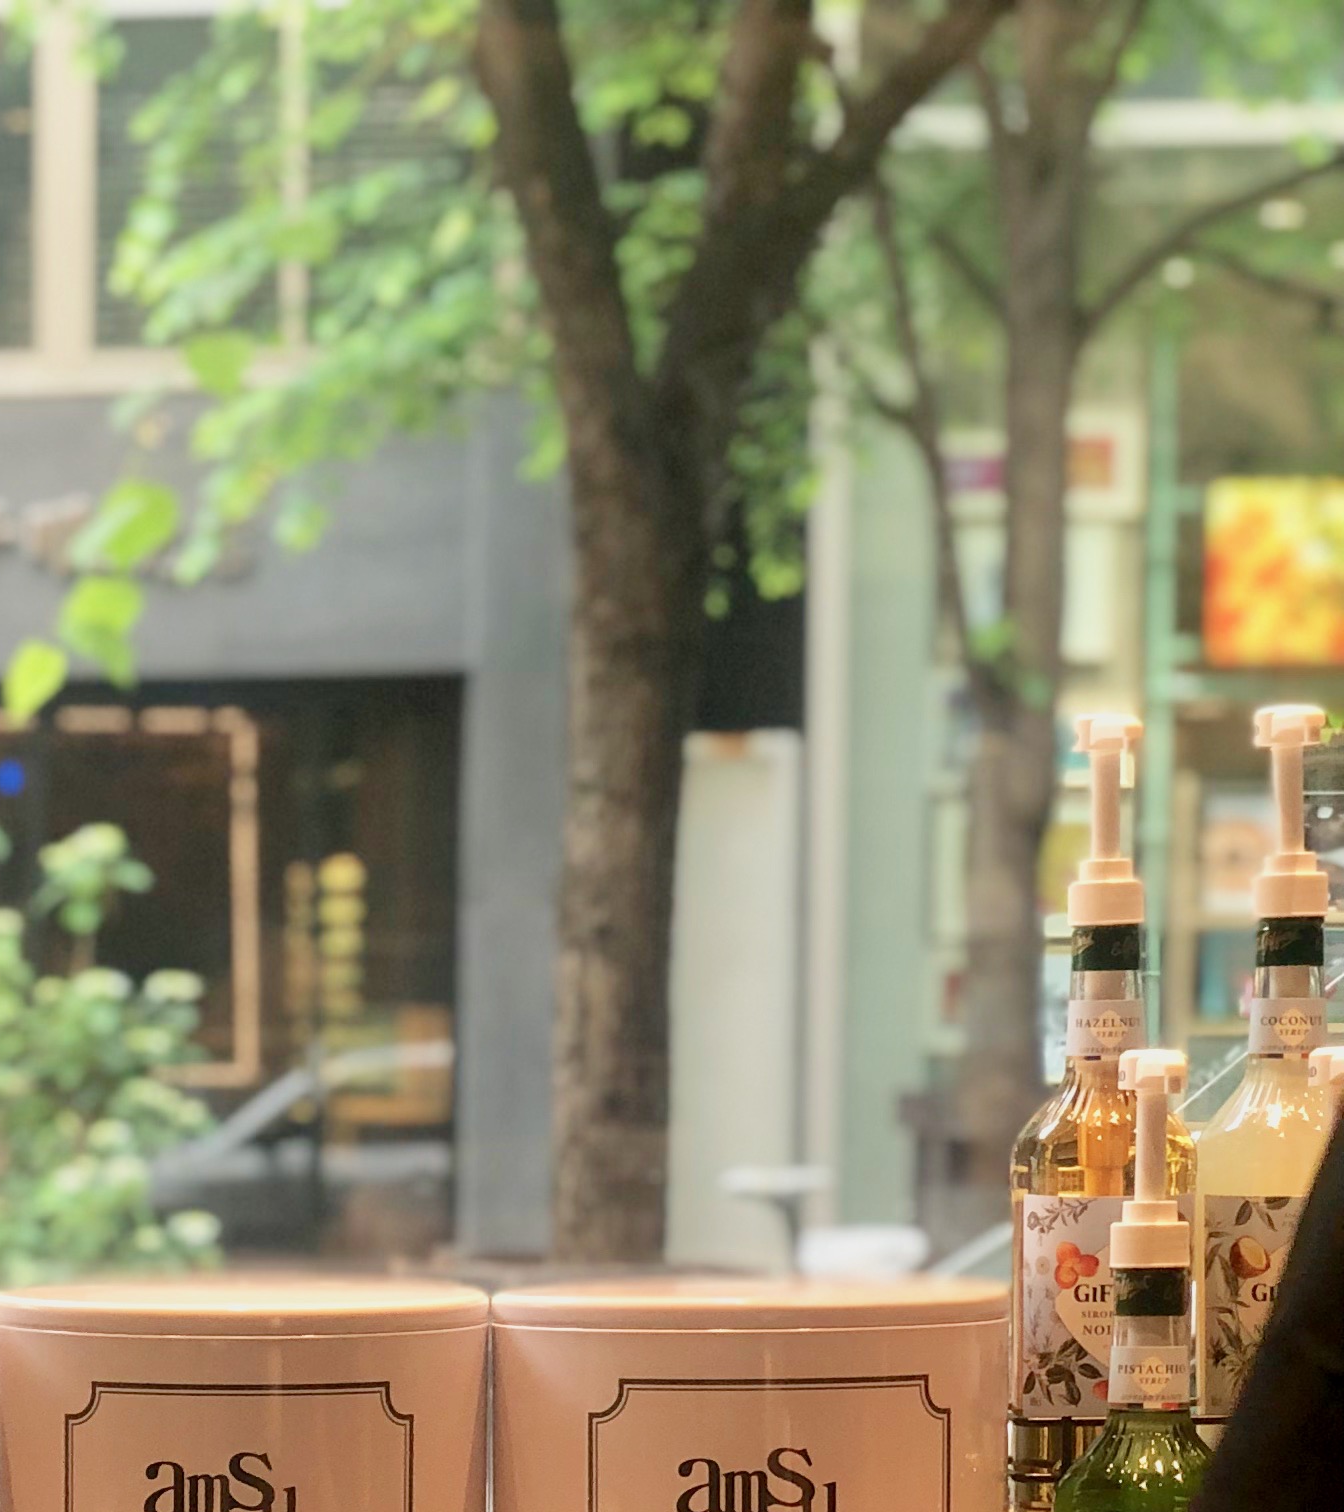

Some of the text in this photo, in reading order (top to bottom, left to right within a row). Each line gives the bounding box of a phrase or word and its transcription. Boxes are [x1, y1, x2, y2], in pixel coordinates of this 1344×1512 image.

[1075, 1017, 1140, 1028] HAZELNUT
[1261, 1015, 1322, 1026] COCONUT
[1279, 1029, 1310, 1037] SYRUP
[1118, 1364, 1186, 1375] PISTACHIO
[1139, 1377, 1170, 1385] SYRUP
